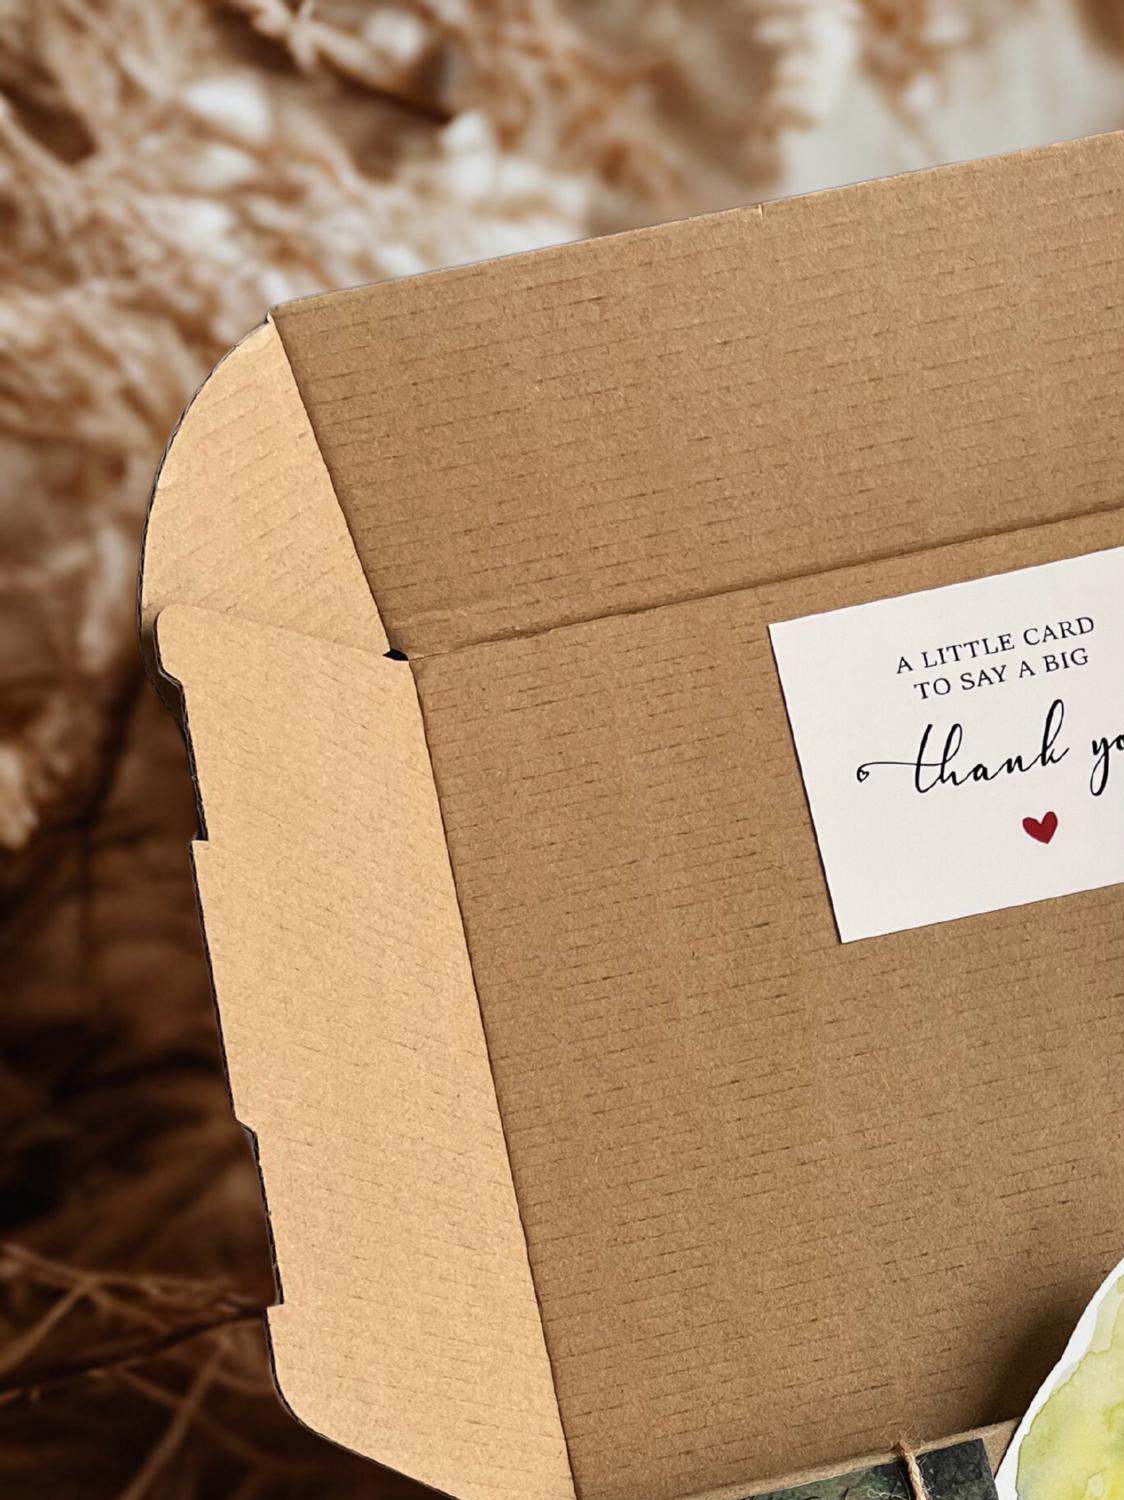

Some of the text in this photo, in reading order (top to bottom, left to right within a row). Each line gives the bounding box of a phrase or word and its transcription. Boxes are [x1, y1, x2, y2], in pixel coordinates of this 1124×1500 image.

[896, 615, 1096, 675] A LITTLE CARD
[913, 647, 1089, 700] TO SAY A BIG
[857, 699, 1070, 793] thank
